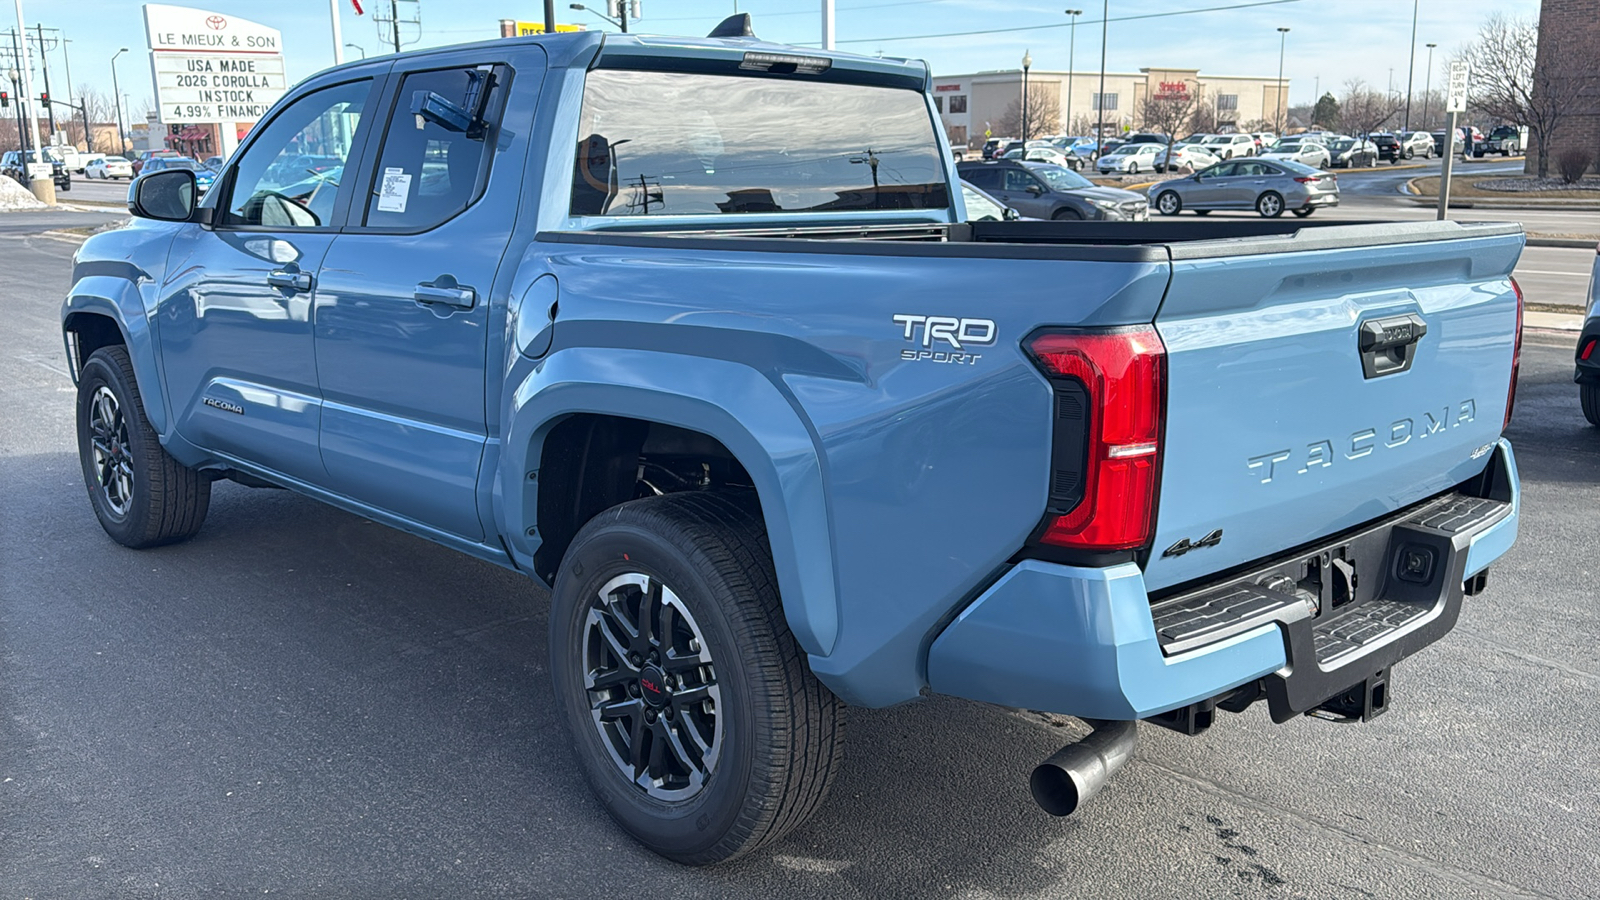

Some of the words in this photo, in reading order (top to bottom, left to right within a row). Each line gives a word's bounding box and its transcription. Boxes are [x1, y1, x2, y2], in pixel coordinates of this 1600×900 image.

[158, 33, 176, 45] LE
[182, 34, 225, 46] MIEUX
[231, 35, 240, 47] &
[247, 36, 275, 47] SON
[187, 59, 213, 72] USA
[219, 60, 255, 72] MADE
[176, 75, 208, 87] 2026
[213, 75, 270, 88] COROLLA
[1451, 81, 1466, 89] TURN
[1450, 90, 1464, 98] LANE
[173, 105, 211, 118] 4.99%
[892, 313, 998, 351] TRD
[901, 349, 982, 366] SPORT
[202, 396, 244, 415] TACOMA
[1247, 398, 1476, 484] TACOMA
